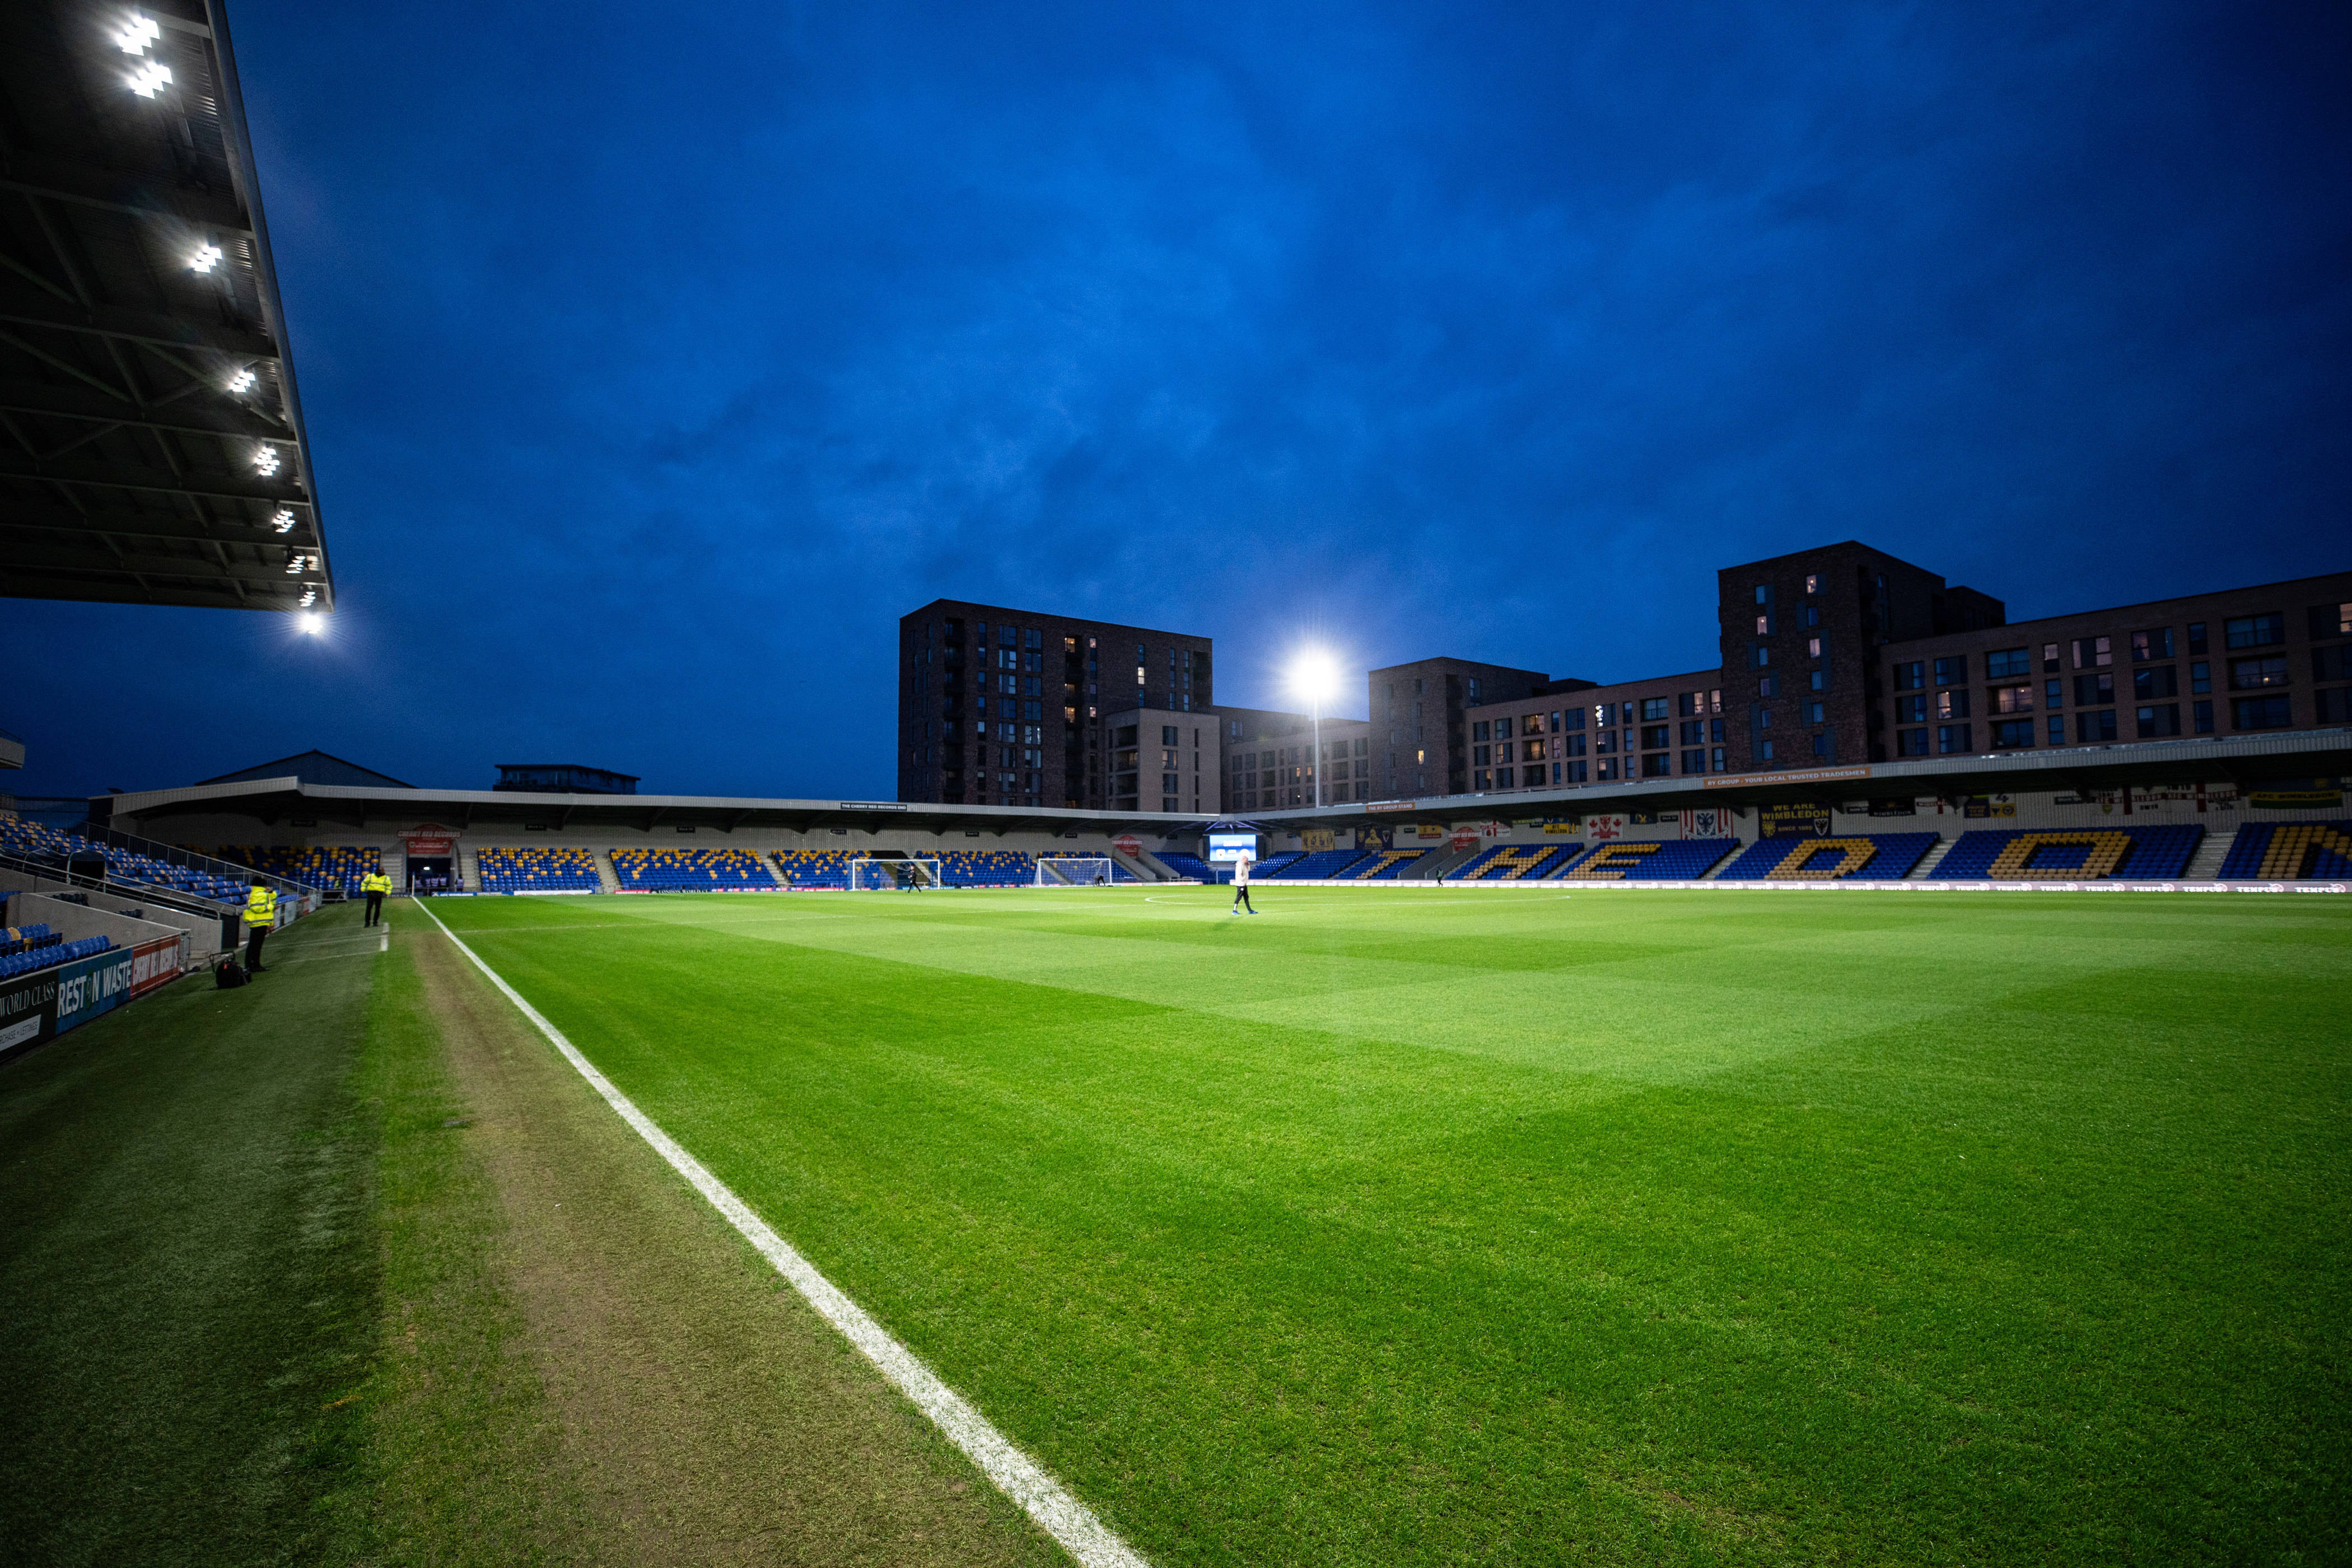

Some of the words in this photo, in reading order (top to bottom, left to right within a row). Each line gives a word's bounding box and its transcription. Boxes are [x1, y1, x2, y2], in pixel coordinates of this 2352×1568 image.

[1821, 769, 1866, 778] TRADESMEN
[1761, 809, 1830, 820] WIMBLEDON
[103, 960, 132, 998] WASTE
[0, 990, 30, 1018] WORLD
[31, 981, 55, 1006] CLASS
